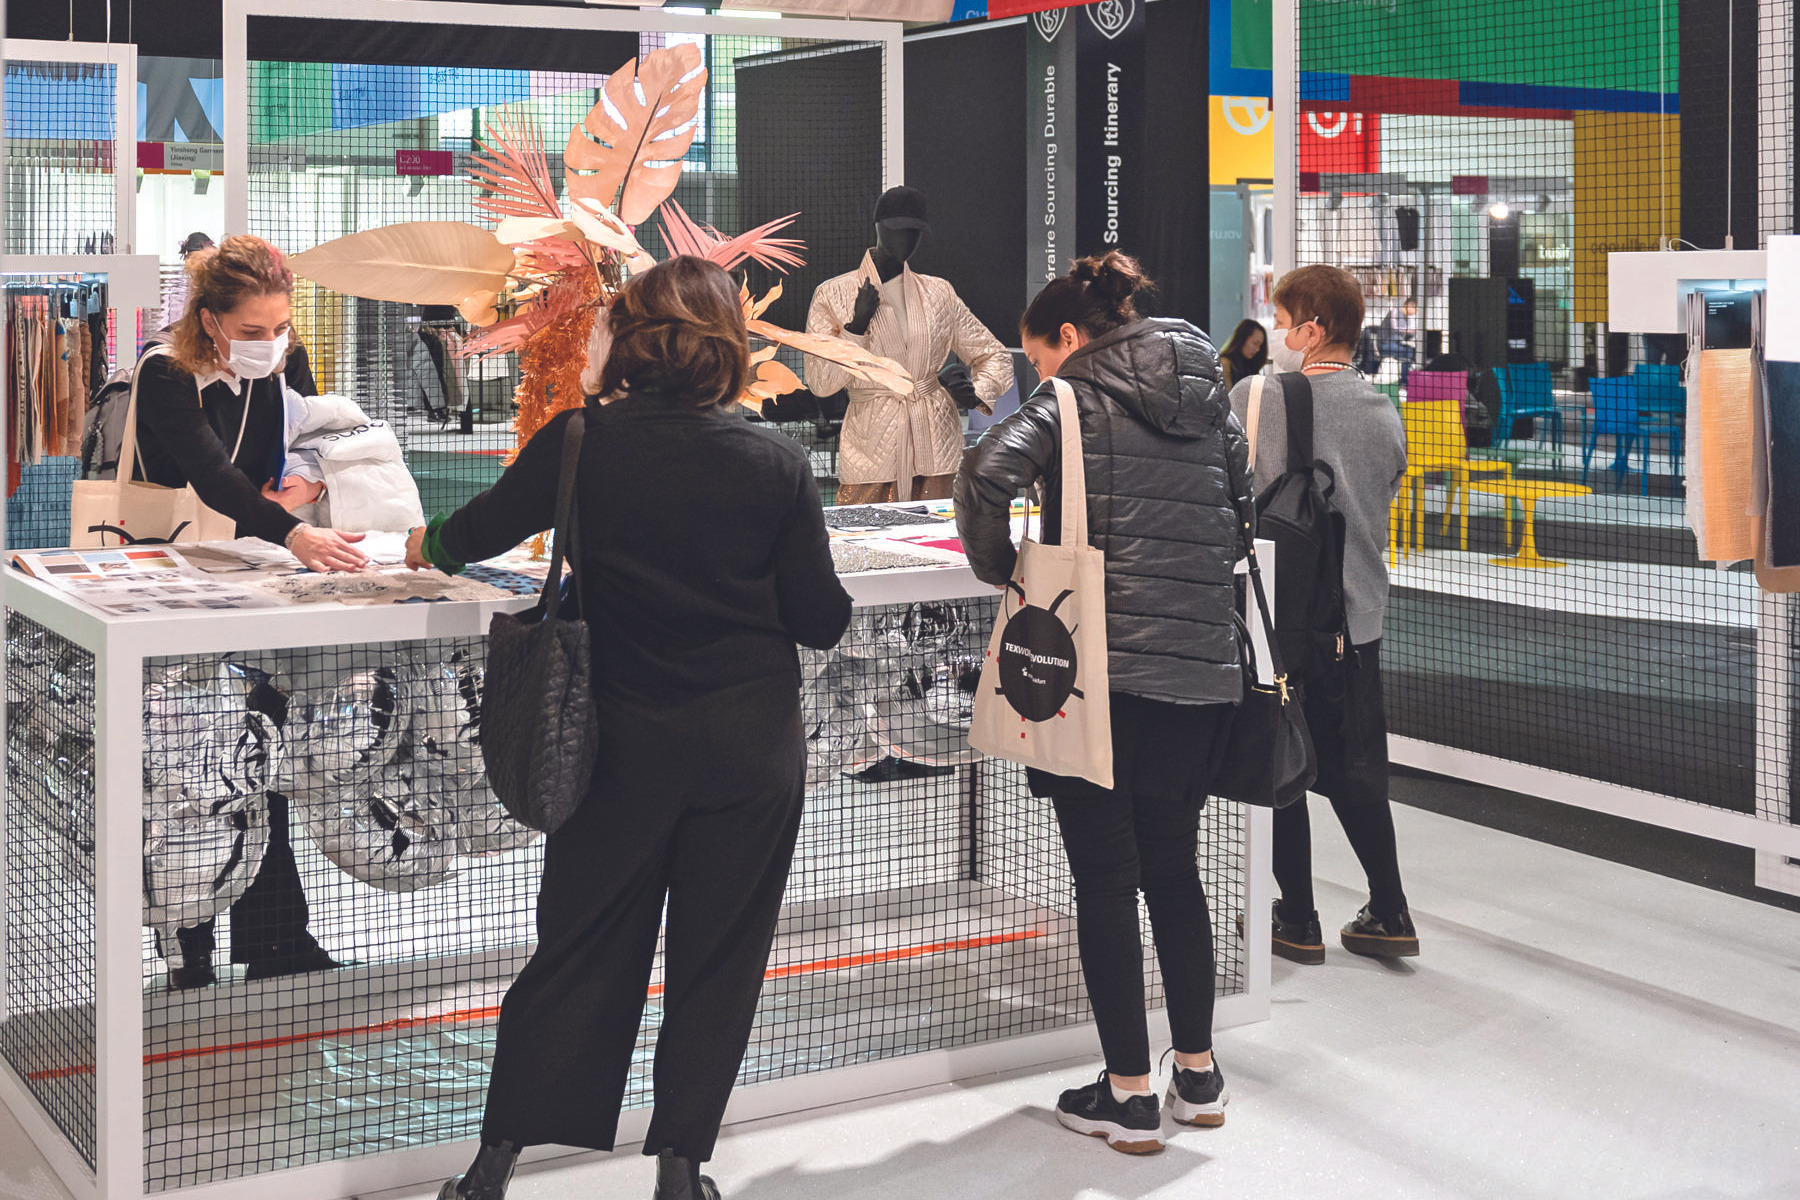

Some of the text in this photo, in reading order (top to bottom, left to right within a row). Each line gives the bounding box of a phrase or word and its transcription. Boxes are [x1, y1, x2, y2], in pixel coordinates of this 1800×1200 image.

[1044, 65, 1055, 137] Durable
[1045, 143, 1057, 225] Sourcing
[1103, 62, 1121, 243] Sourcing Itinerary
